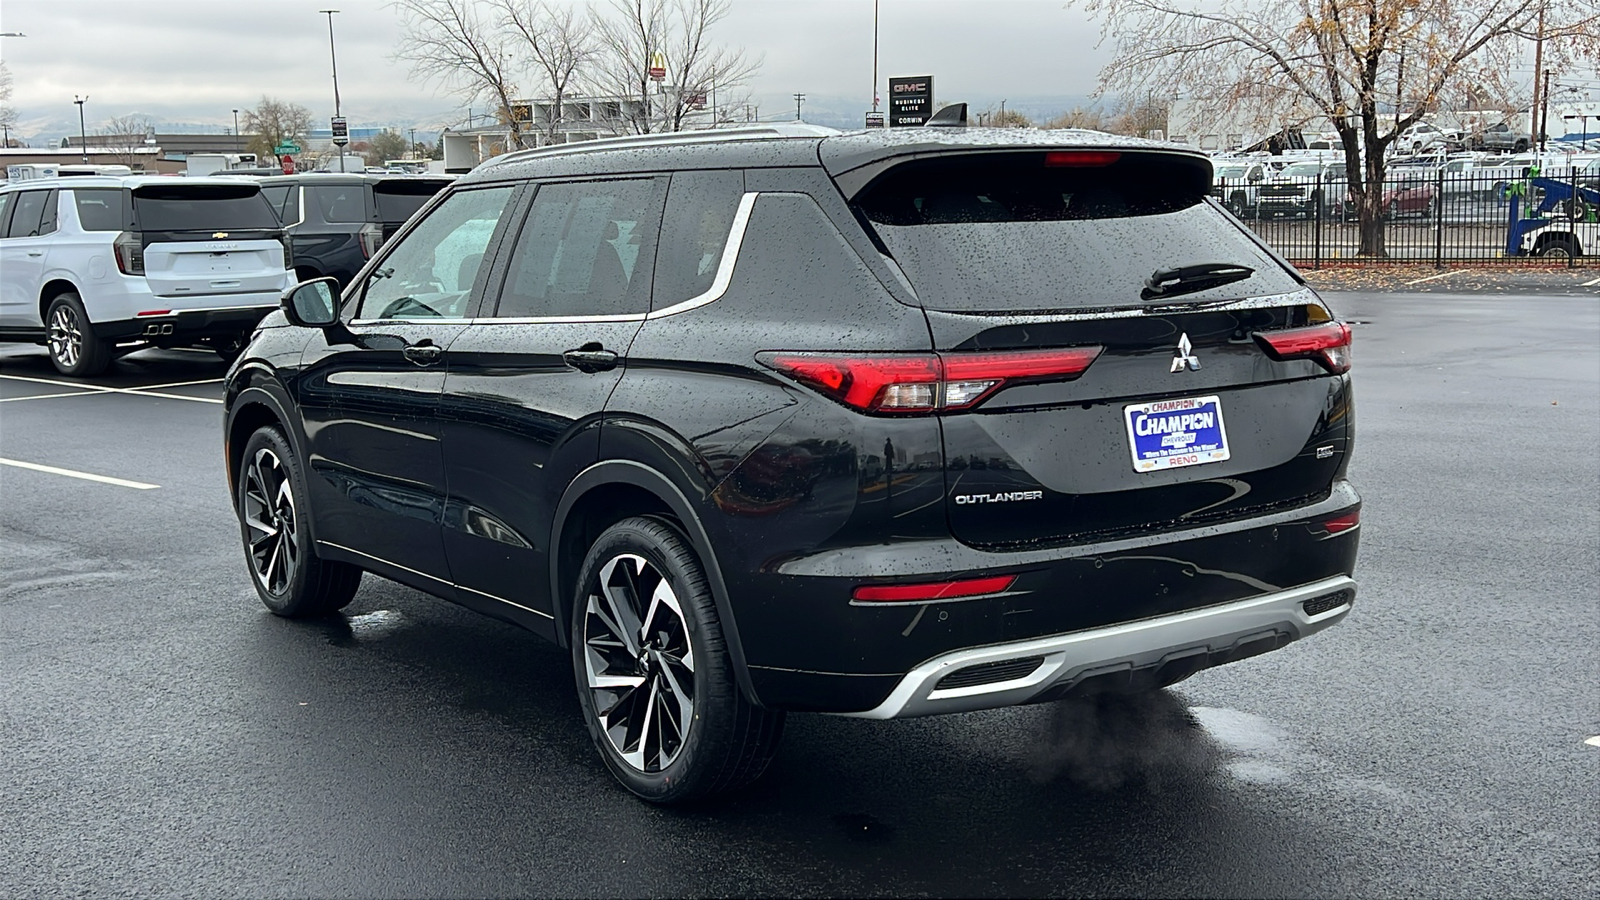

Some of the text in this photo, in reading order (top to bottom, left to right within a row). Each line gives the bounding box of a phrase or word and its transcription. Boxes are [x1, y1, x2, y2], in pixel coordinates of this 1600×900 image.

[893, 83, 926, 93] GMC
[1151, 399, 1195, 413] CHAMPION
[1136, 412, 1214, 437] CHAMPION
[1163, 434, 1195, 444] CHEVROLET
[1169, 454, 1198, 467] RENO
[955, 490, 1043, 505] OUTLANDER
